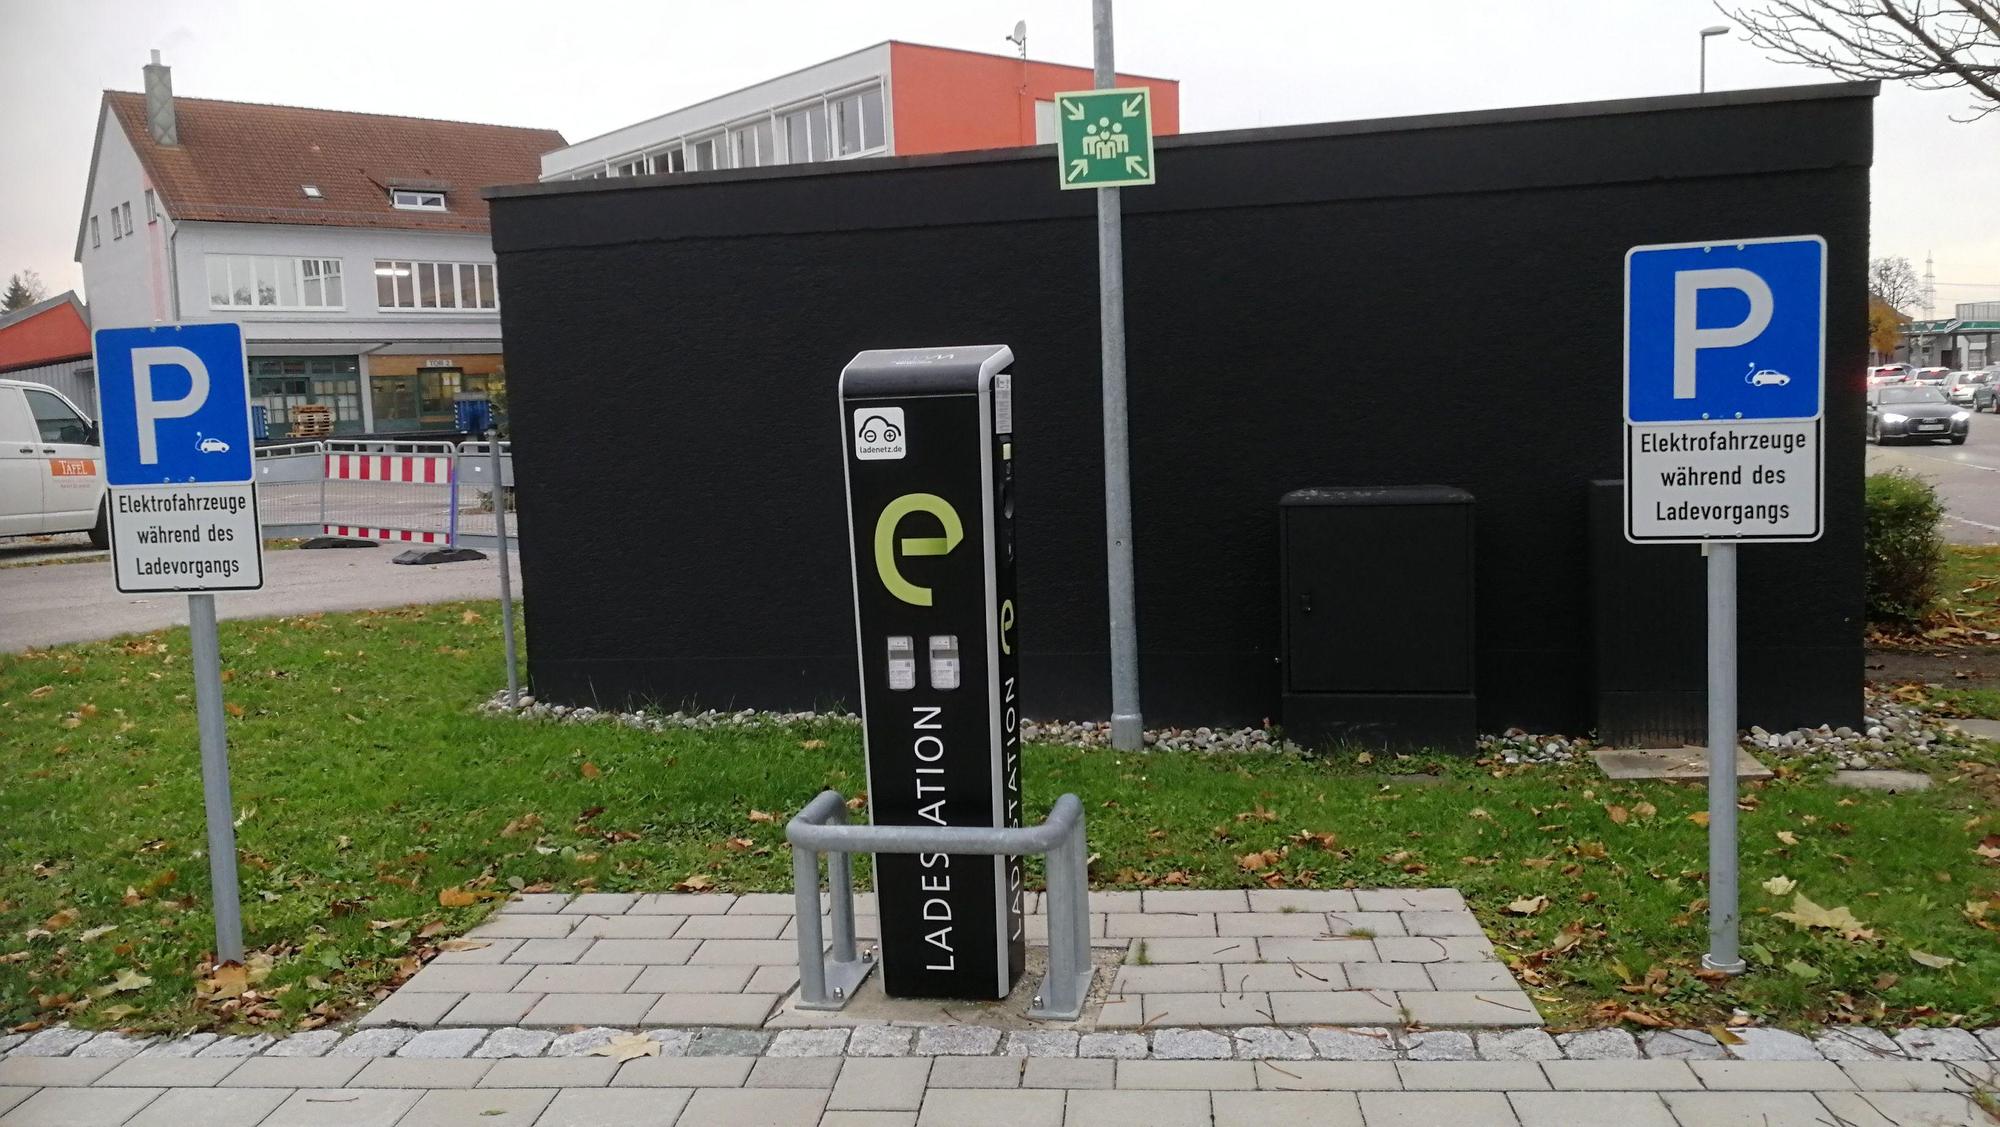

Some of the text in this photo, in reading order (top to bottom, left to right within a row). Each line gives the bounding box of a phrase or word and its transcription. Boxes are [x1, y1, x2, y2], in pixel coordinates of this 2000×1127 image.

[1673, 267, 1774, 400] P
[130, 346, 210, 465] P
[859, 445, 902, 454] ladenetz.de
[1641, 430, 1806, 455] Elektrofahrzeuge
[1661, 464, 1785, 487] während des
[119, 493, 246, 515] Elektrofahrzeuge
[1656, 501, 1790, 524] Ladevorgangs
[137, 523, 234, 544] während des
[136, 557, 240, 578] Ladevorgangs
[912, 706, 955, 972] LADESATION
